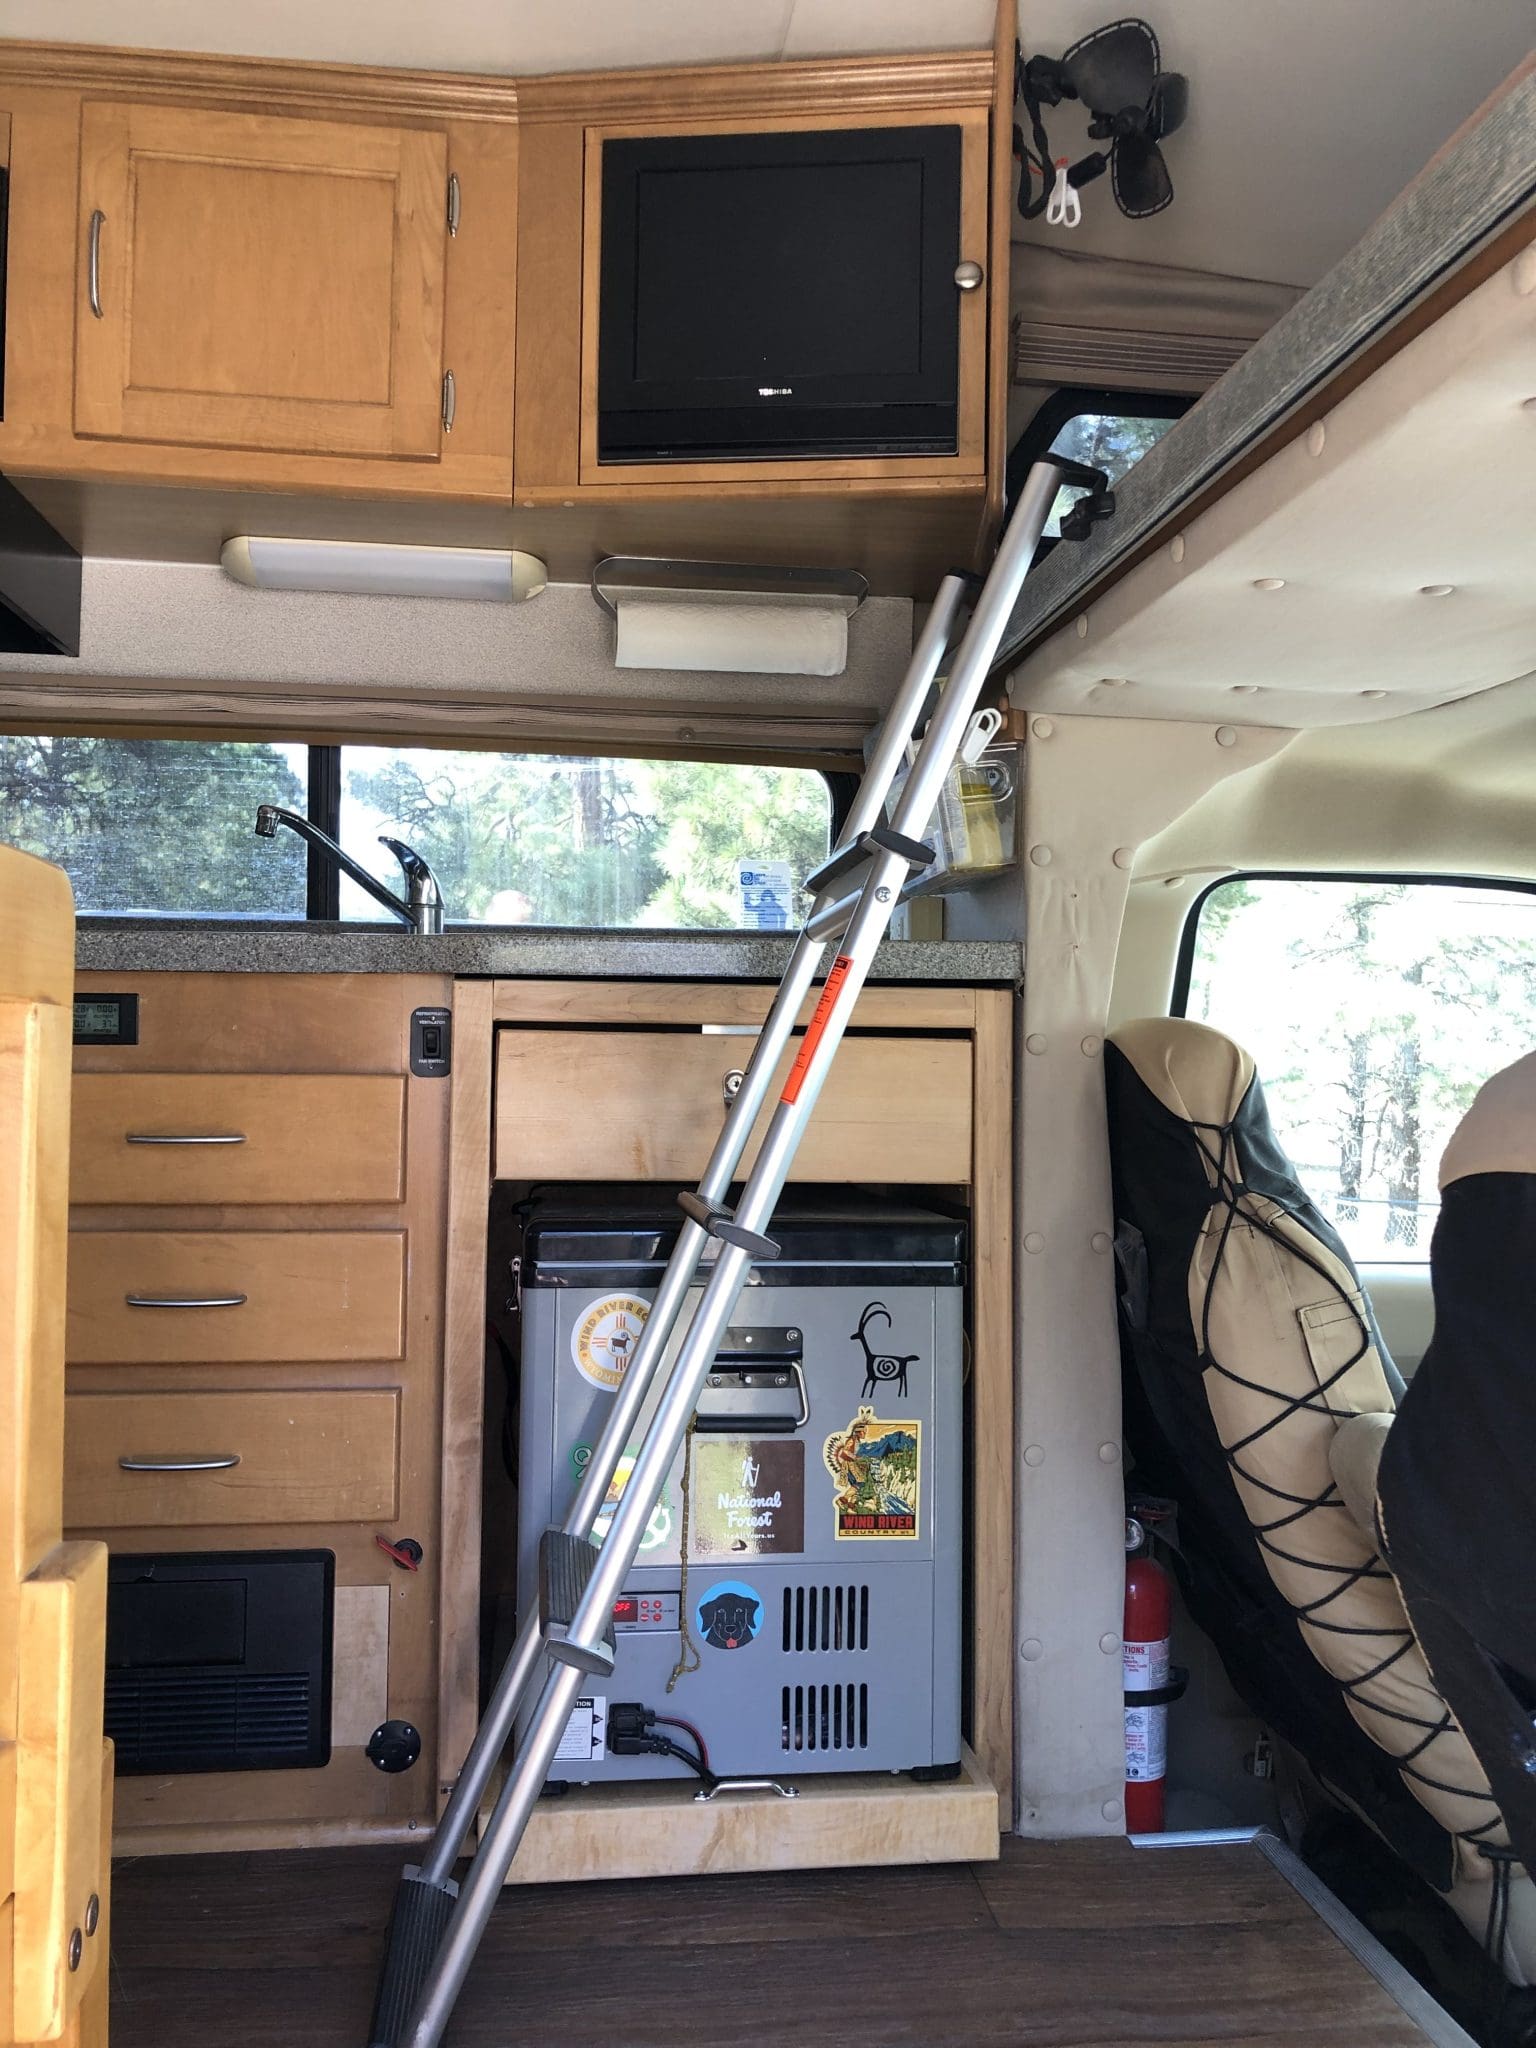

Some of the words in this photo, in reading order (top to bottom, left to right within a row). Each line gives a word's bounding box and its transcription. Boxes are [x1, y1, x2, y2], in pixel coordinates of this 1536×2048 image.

[759, 388, 793, 396] TOSHIBA
[580, 1318, 597, 1351] WIND
[597, 1301, 633, 1318] RIVER
[584, 1360, 622, 1384] WYOMIN
[717, 1491, 782, 1510] National
[726, 1511, 773, 1528] Forest
[843, 1516, 874, 1528] WIND
[878, 1515, 912, 1528] RIVER
[1122, 1645, 1145, 1654] TIONS
